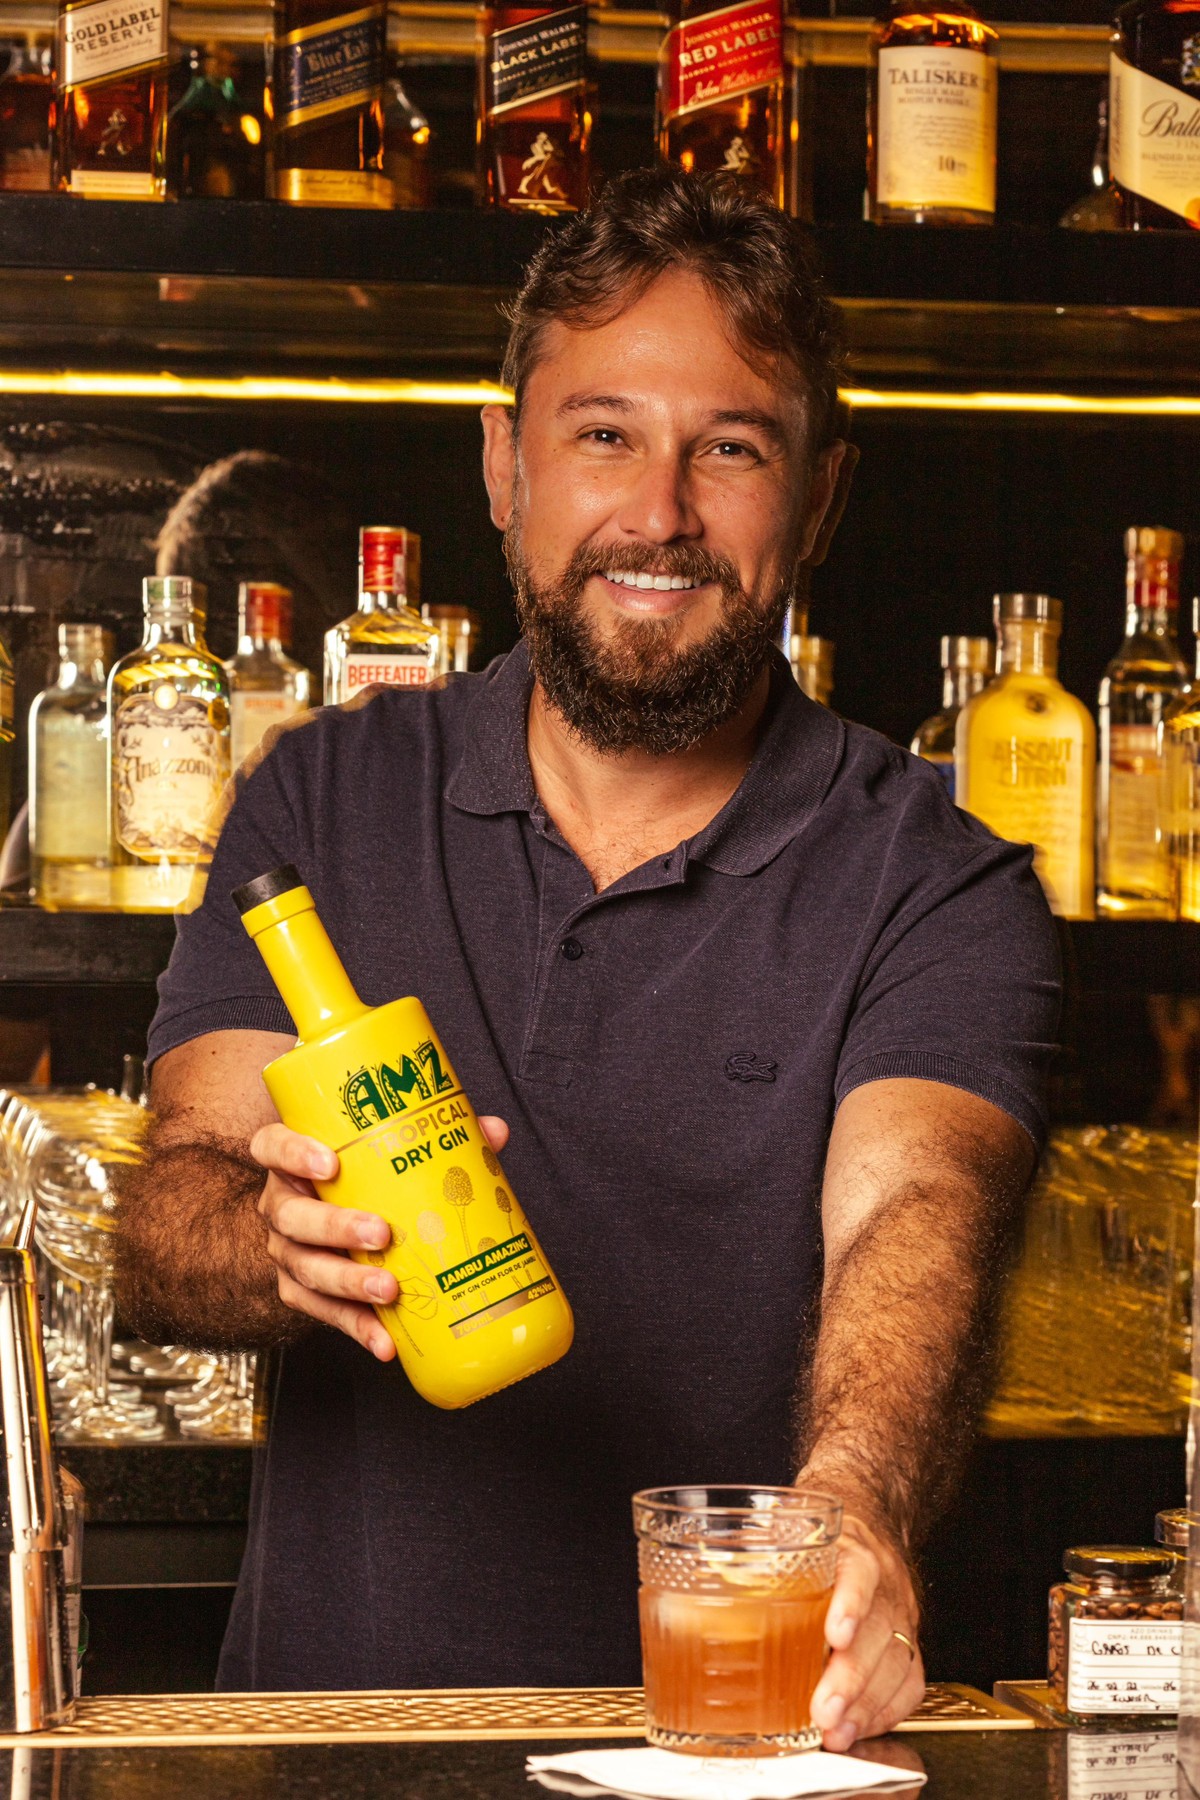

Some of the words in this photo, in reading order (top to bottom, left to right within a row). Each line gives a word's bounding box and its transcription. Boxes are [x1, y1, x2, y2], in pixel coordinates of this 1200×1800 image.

[75, 21, 156, 53] RESERVE
[109, 7, 160, 31] LABEL
[490, 49, 539, 73] BLACK
[679, 45, 717, 67] RED
[721, 26, 780, 53] LABEL
[888, 68, 979, 87] TALISKER
[348, 664, 427, 688] BEEFEATER
[343, 1039, 455, 1131] AMZ
[368, 1101, 469, 1158] TROPICAL
[391, 1141, 433, 1175] DRY
[438, 1125, 470, 1151] GIN
[441, 1259, 484, 1291] JAMBU
[484, 1237, 528, 1267] AMAZING
[452, 1291, 467, 1301] DRY
[467, 1283, 481, 1293] GIN
[481, 1275, 497, 1287] COM
[498, 1266, 514, 1279] FLOR
[513, 1262, 522, 1271] DE
